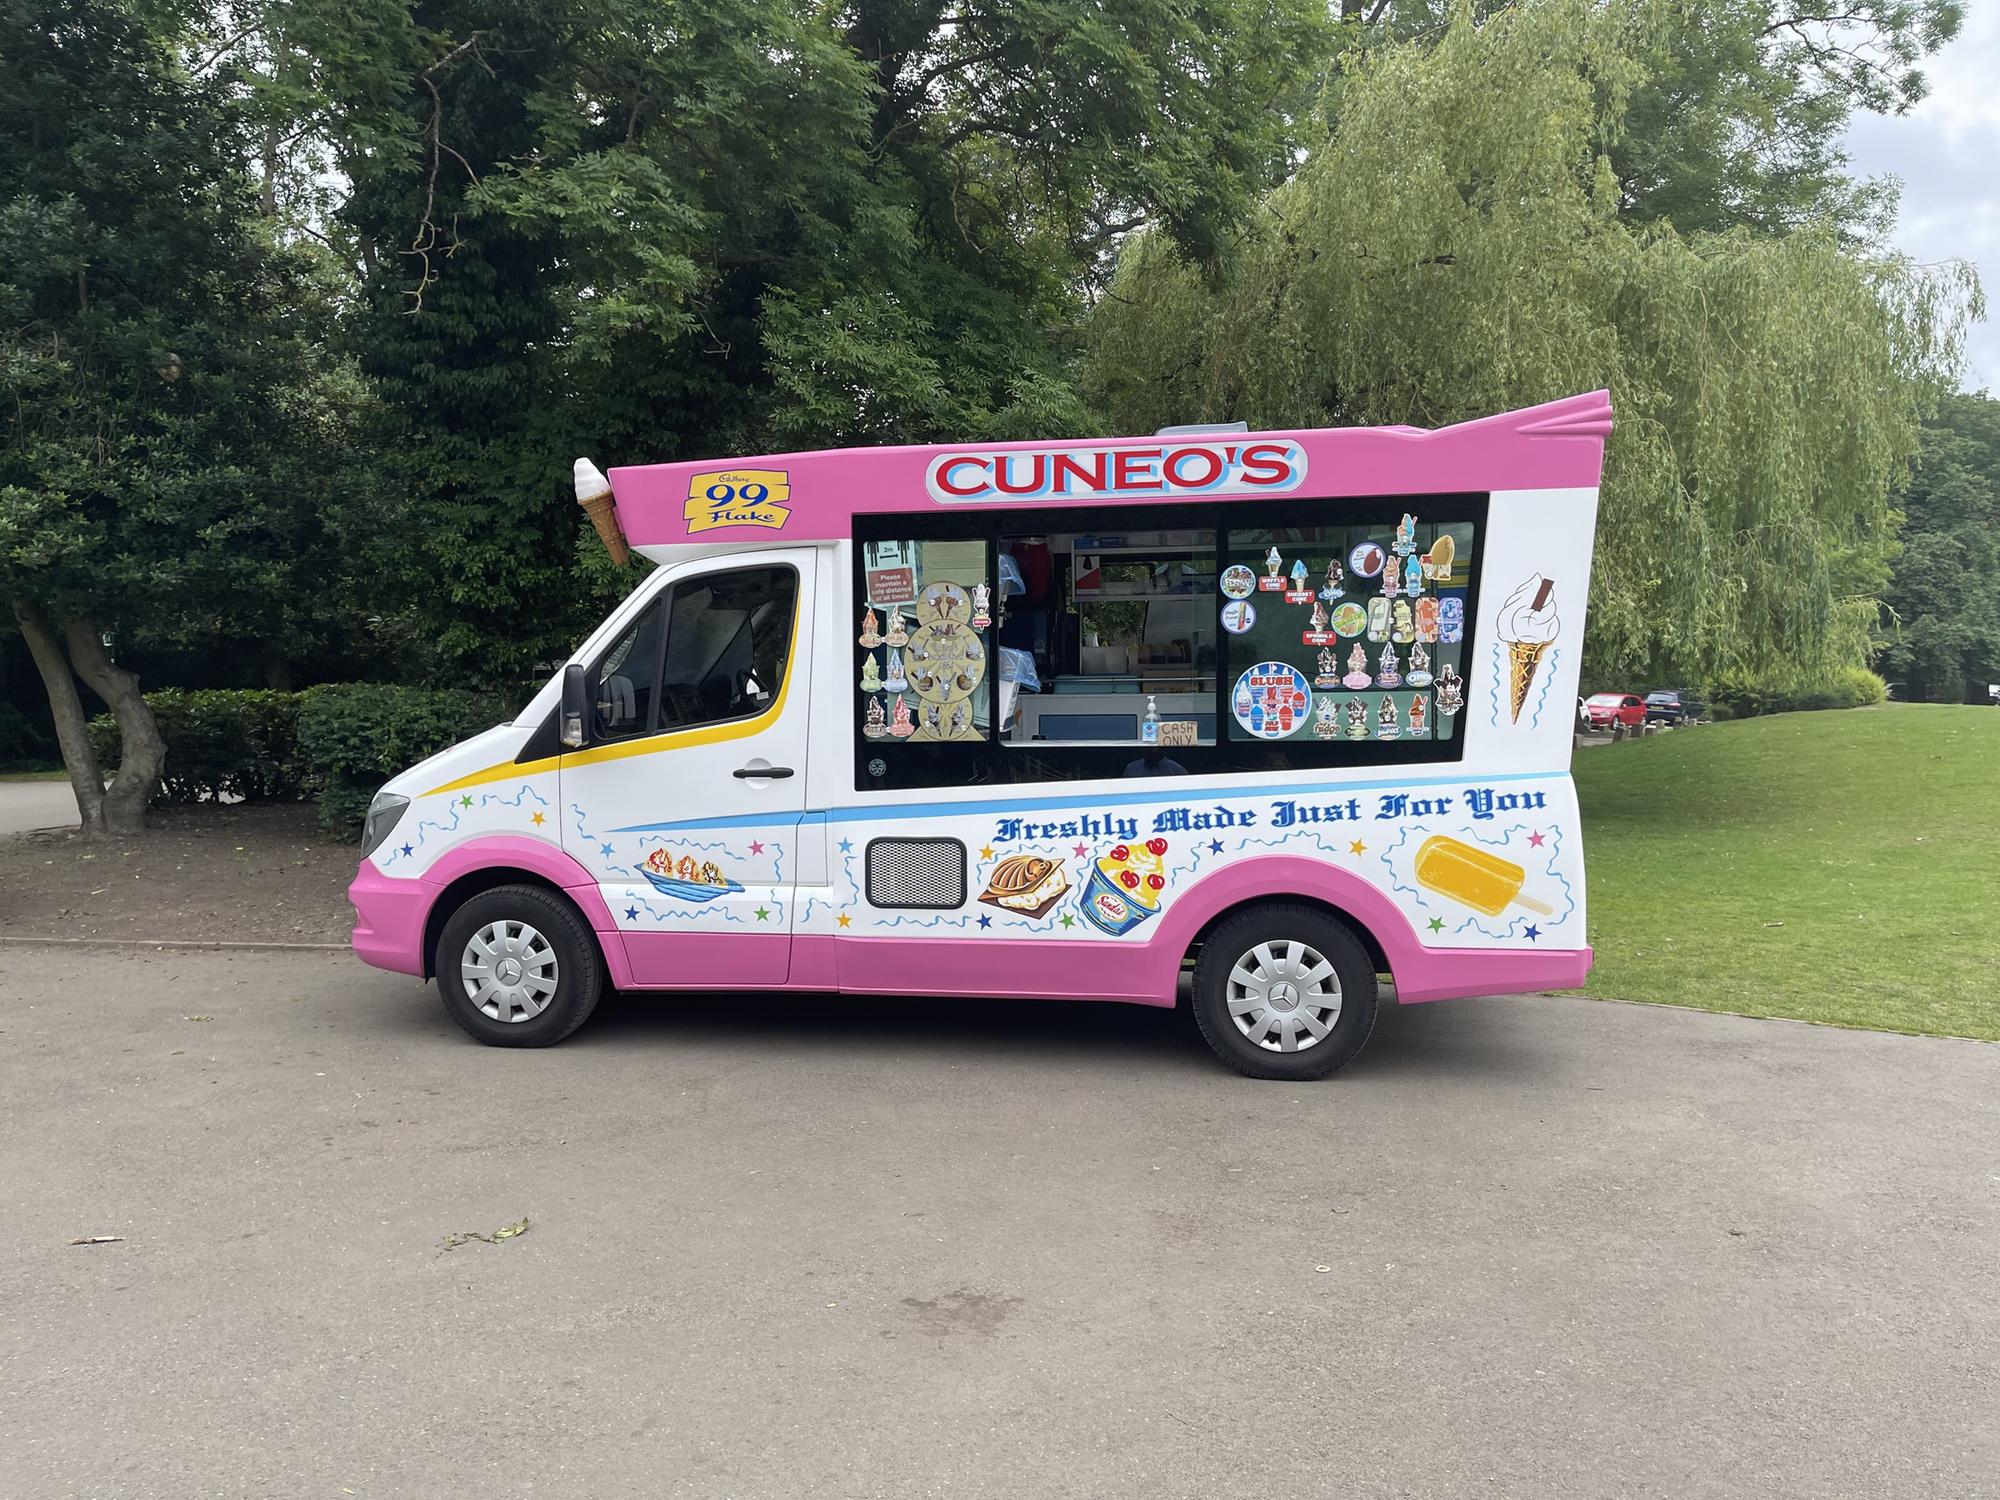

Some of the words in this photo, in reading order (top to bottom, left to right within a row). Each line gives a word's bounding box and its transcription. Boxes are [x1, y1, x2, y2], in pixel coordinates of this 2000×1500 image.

[935, 444, 1296, 497] CUNEO'S
[706, 483, 769, 508] 99
[707, 508, 775, 523] Flake
[1250, 676, 1294, 686] SLUSH
[1161, 722, 1196, 734] CASH
[1314, 722, 1341, 735] fudge
[1162, 735, 1192, 746] ONLY
[992, 812, 1139, 843] Freshly
[1152, 805, 1257, 833] Made
[1271, 799, 1362, 828] Just
[1374, 793, 1454, 820] For
[1463, 788, 1547, 820] You
